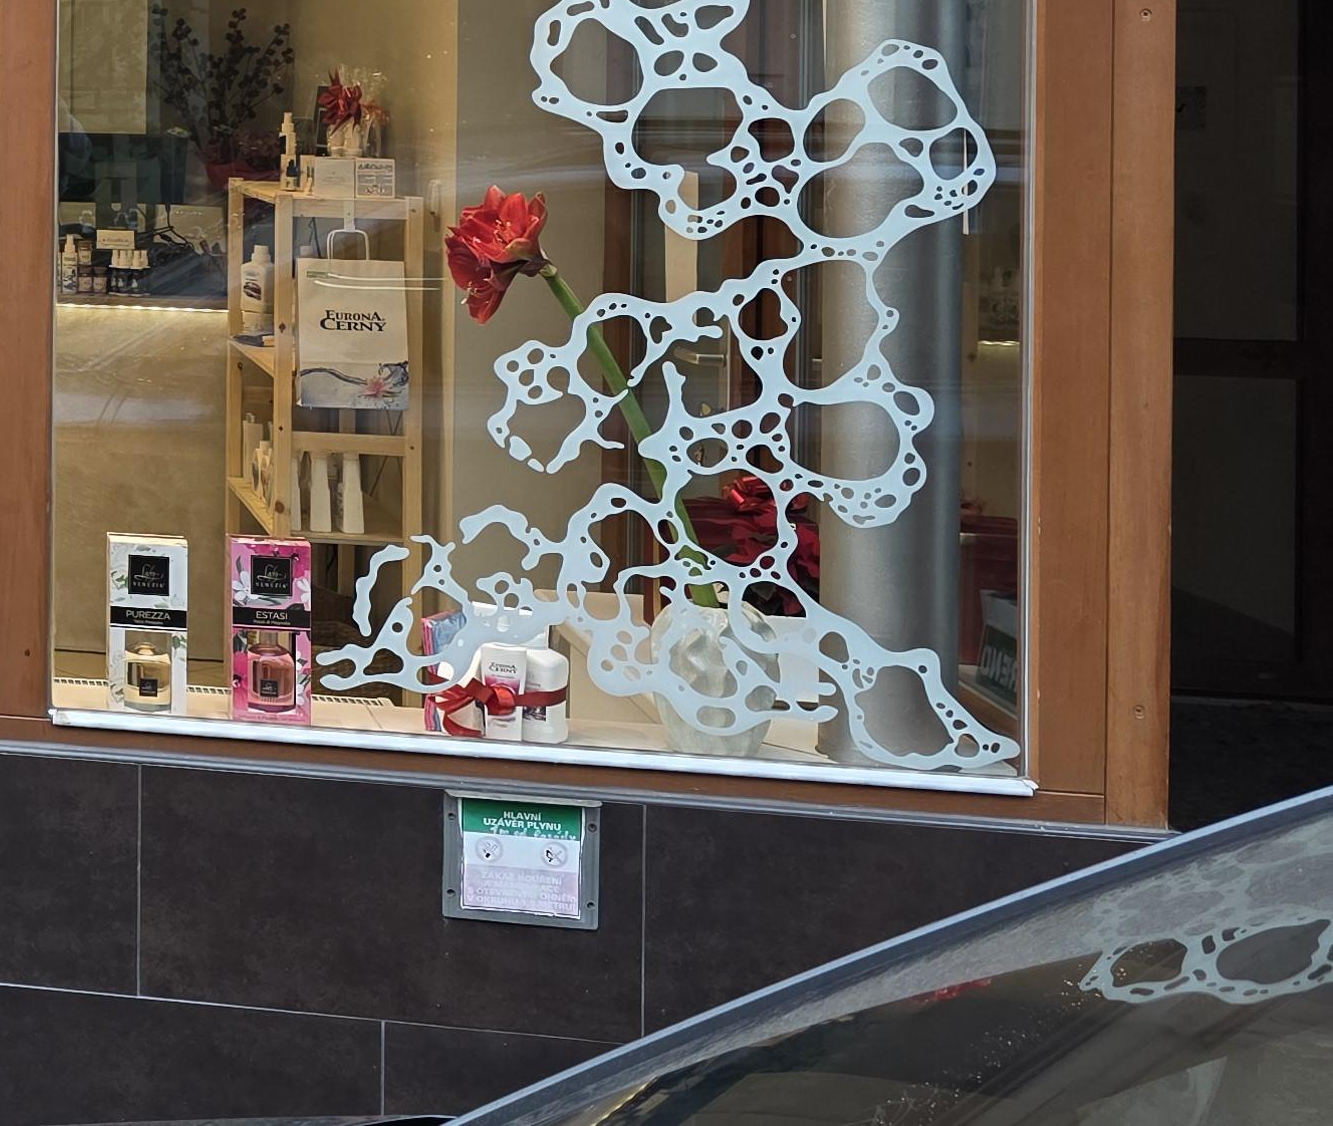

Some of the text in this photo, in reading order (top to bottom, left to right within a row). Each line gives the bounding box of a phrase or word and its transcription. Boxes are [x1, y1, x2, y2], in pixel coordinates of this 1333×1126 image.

[320, 318, 386, 331] CERNY
[126, 610, 171, 620] PUREZZA
[255, 610, 288, 620] ESTASI
[503, 811, 542, 821] HLAVNÍ
[527, 821, 562, 831] PLYNU
